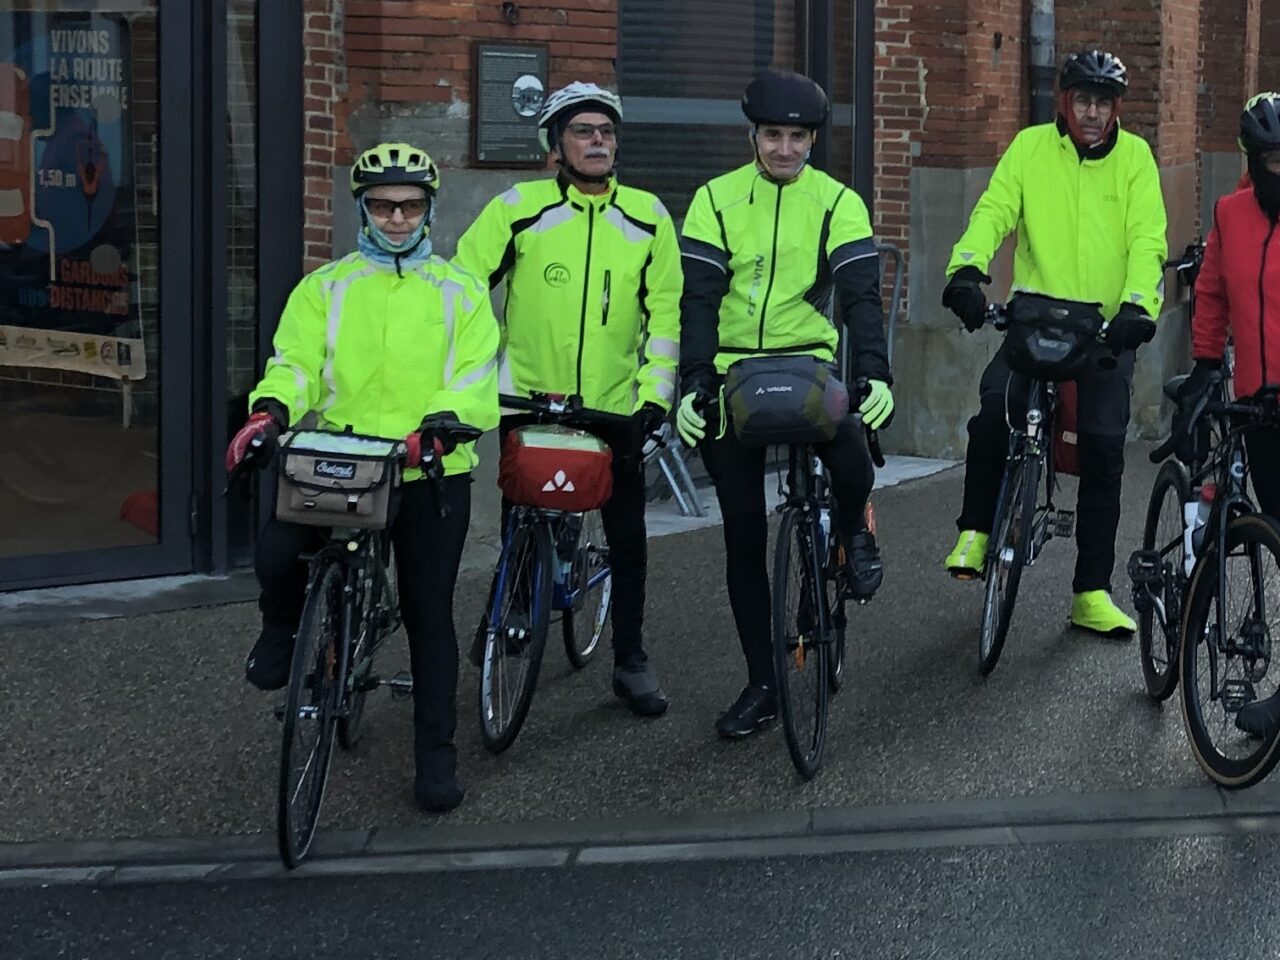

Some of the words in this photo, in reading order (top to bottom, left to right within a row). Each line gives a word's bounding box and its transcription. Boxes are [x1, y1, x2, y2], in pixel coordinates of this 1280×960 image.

[51, 30, 110, 55] VIVONS
[50, 58, 69, 81] LA
[73, 58, 123, 82] ROUTE
